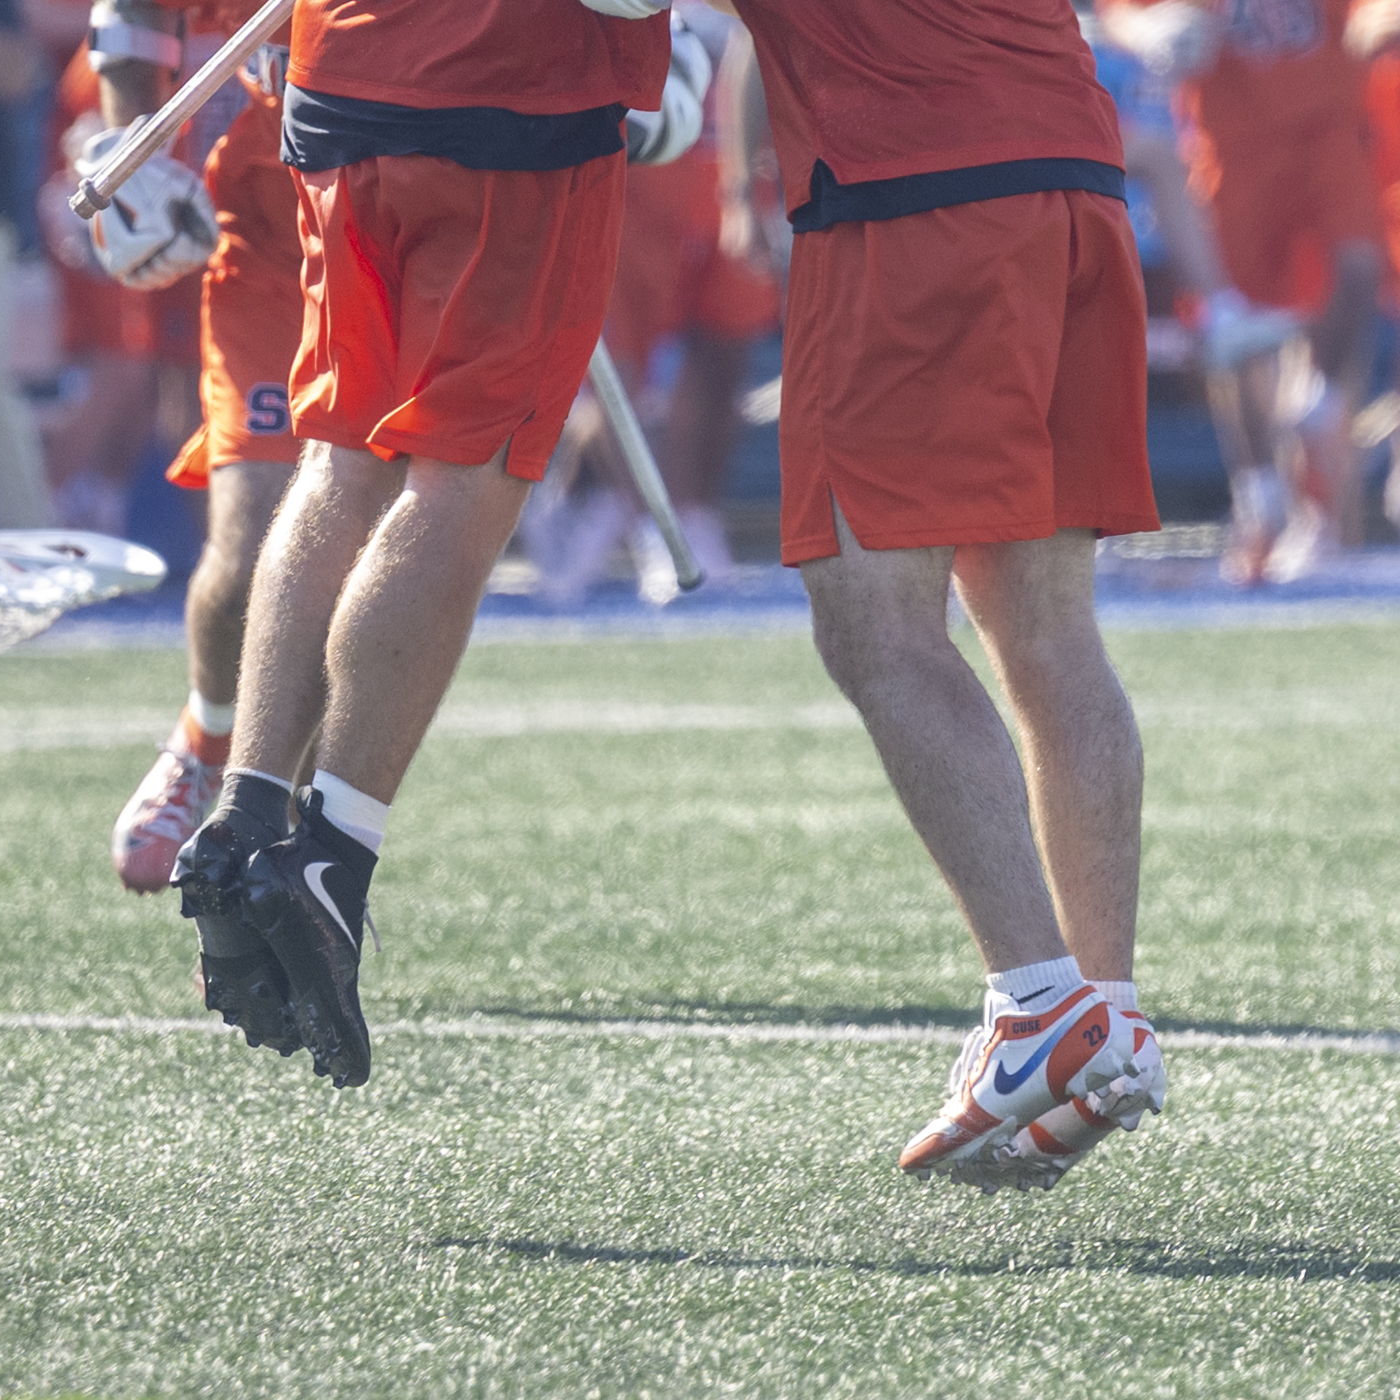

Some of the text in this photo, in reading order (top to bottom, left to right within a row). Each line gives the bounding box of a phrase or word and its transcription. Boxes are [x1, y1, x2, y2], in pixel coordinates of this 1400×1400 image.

[246, 382, 291, 436] S
[1012, 1019, 1041, 1034] CUSE
[1083, 1024, 1106, 1047] 22
